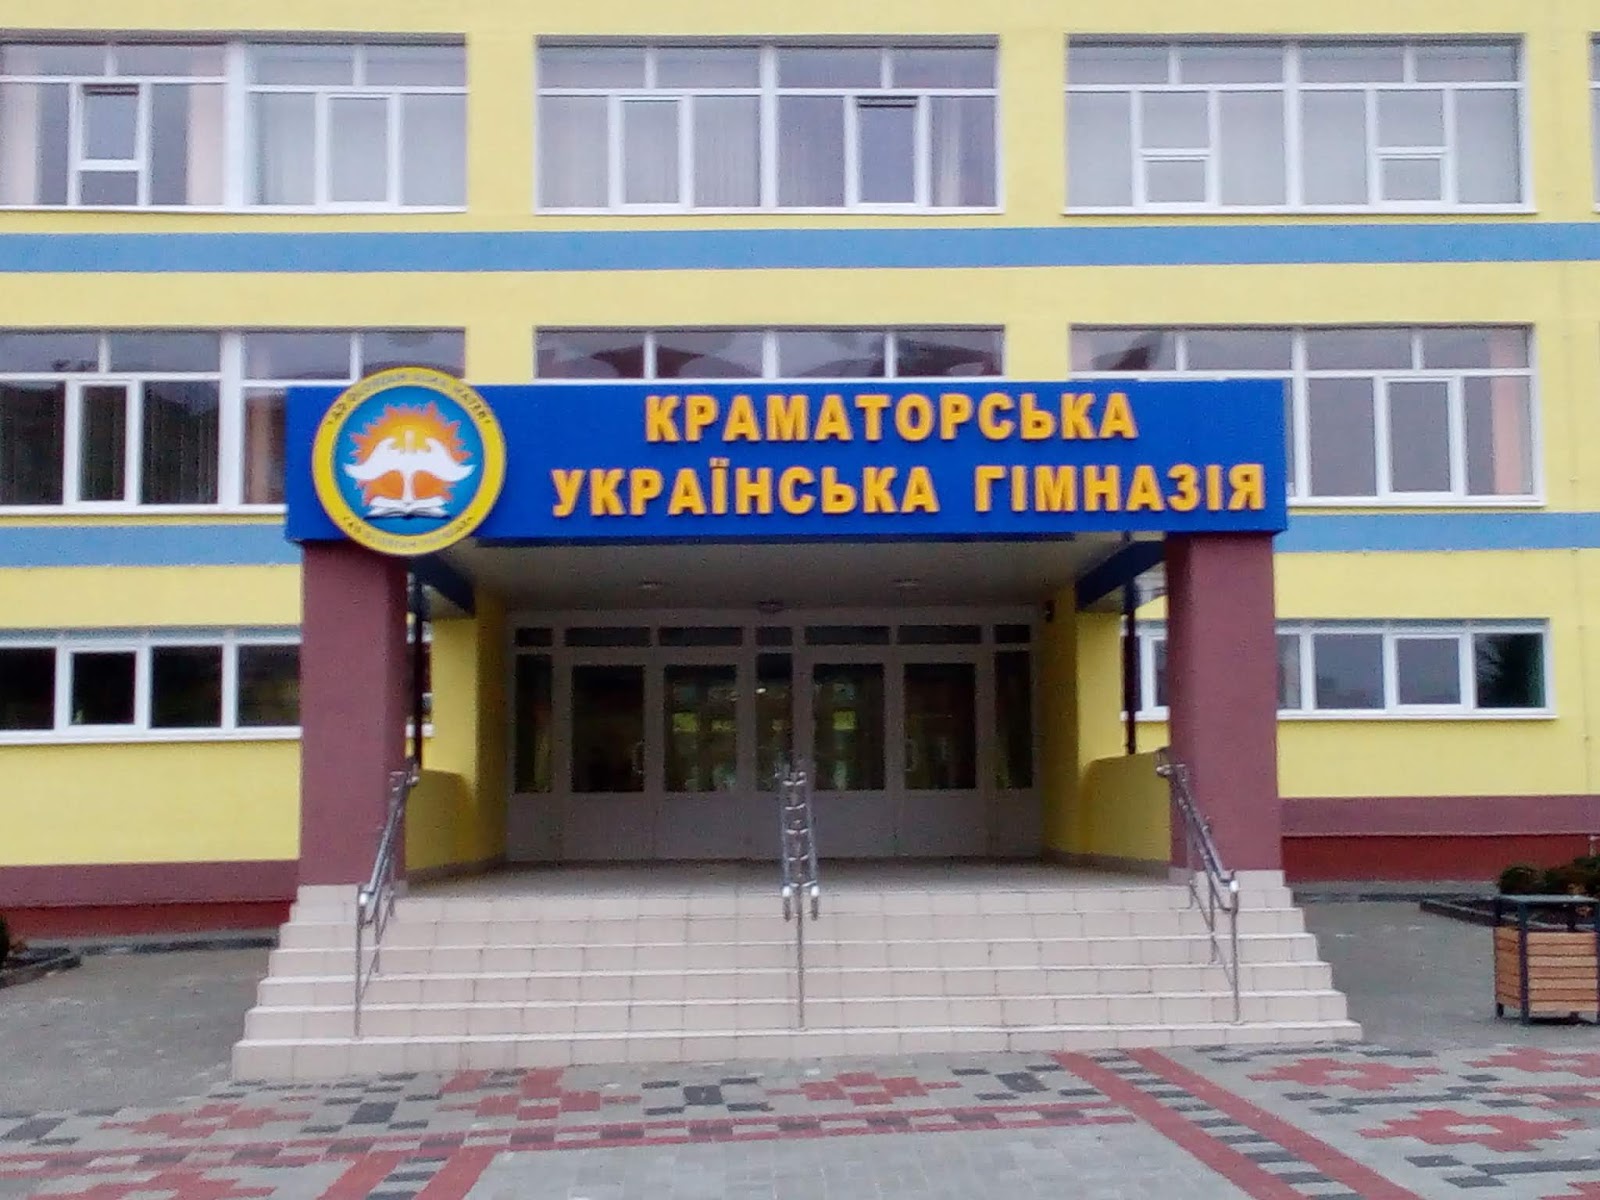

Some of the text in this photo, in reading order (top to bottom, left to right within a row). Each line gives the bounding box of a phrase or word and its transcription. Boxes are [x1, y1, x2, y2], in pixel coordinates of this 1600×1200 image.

[645, 392, 1137, 443] КРАМАТОРСЬКА
[552, 458, 1265, 518] УКРАЇНСЬКА ГІМНАЗІЯ
